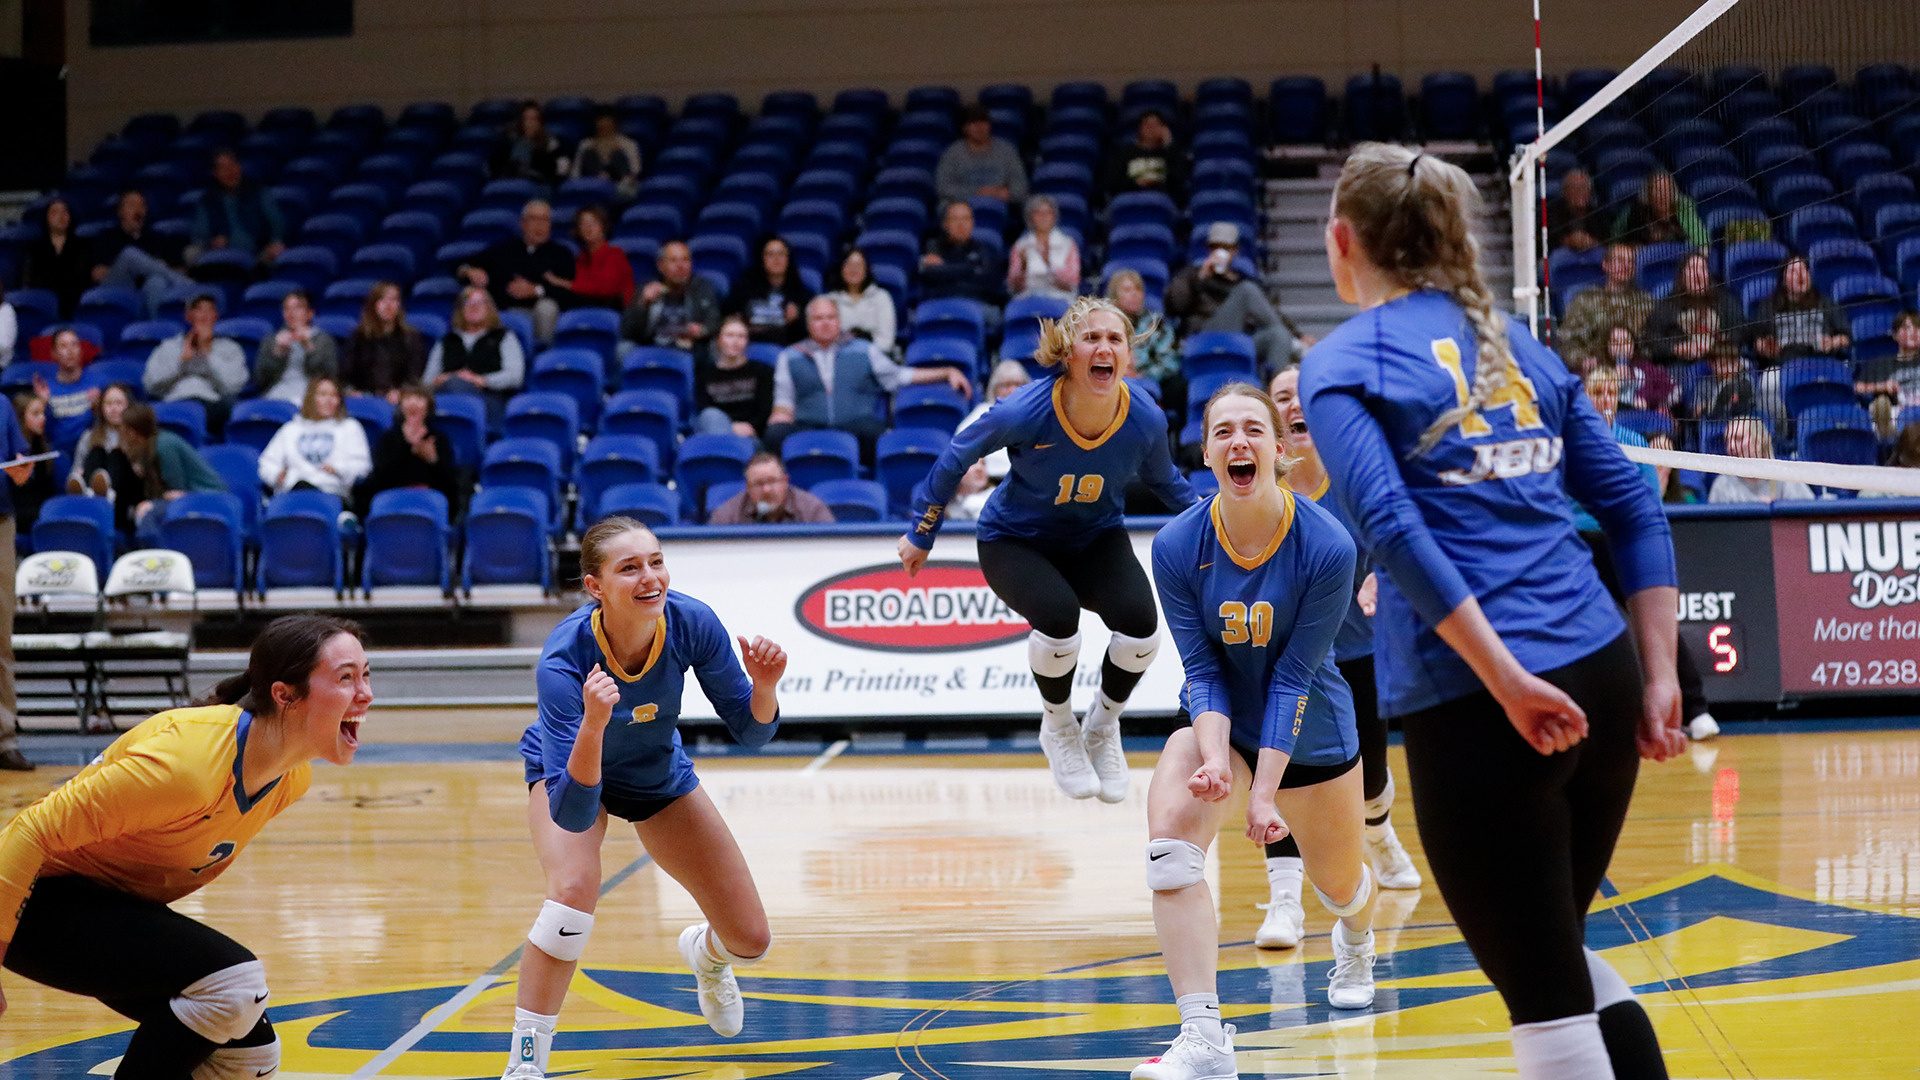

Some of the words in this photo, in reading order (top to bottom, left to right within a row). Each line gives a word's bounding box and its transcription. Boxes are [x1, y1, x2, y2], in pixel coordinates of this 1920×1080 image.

[1431, 337, 1545, 440] 14
[1438, 437, 1564, 486] JBU
[1054, 474, 1104, 505] 19
[829, 591, 1014, 624] BROADWA
[1676, 592, 1736, 621] UEST
[1219, 601, 1274, 647] 30
[1813, 616, 1874, 642] More
[1708, 625, 1737, 672] 5
[823, 668, 939, 697] Printing
[945, 666, 968, 691] &
